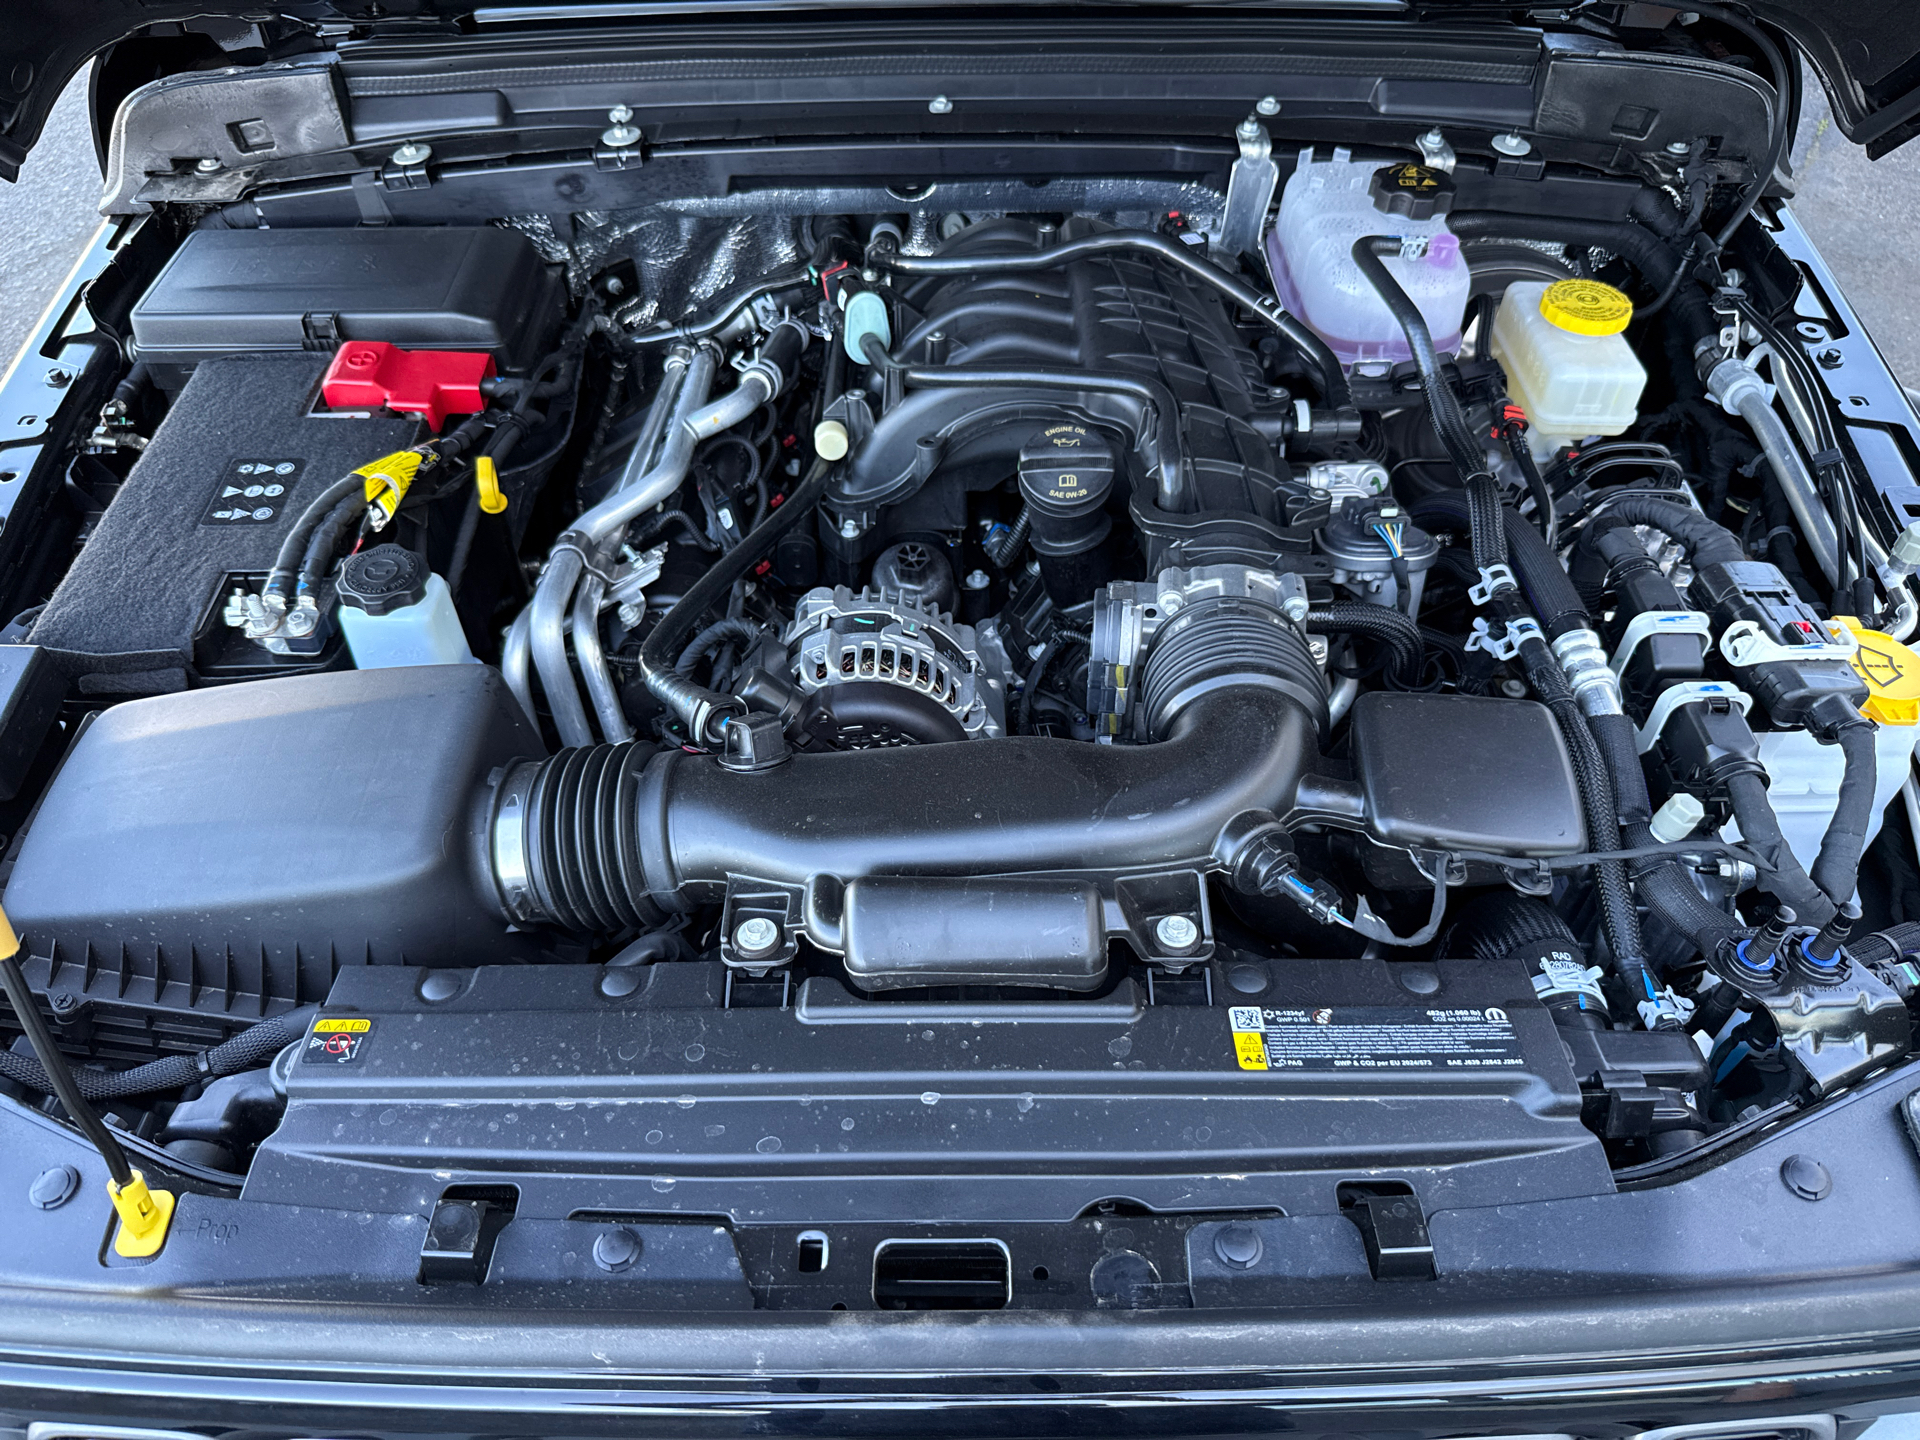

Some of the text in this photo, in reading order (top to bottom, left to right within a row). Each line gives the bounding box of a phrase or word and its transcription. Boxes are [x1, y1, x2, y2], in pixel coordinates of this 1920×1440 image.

[1044, 426, 1087, 437] ENGINE OIL
[1048, 488, 1088, 499] SAE 0W-20
[1551, 951, 1572, 961] RAD
[195, 1218, 239, 1245] Prop
